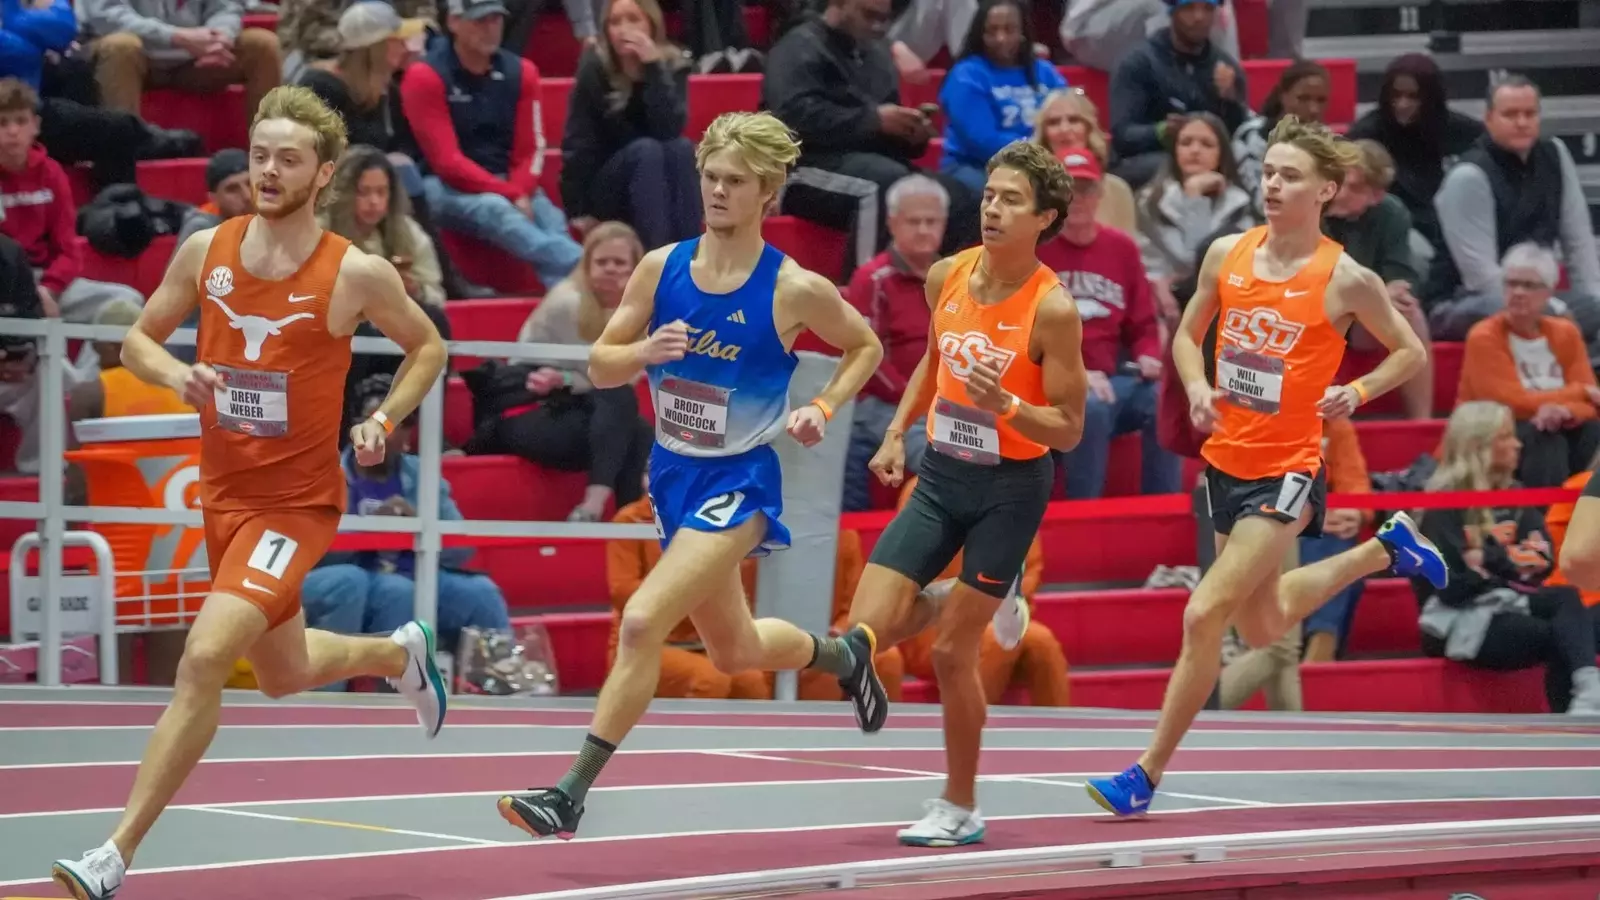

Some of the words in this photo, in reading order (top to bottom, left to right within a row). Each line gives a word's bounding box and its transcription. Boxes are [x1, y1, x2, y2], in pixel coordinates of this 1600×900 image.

[1400, 6, 1419, 31] 11
[1582, 131, 1597, 157] 9
[211, 268, 232, 288] SEC
[1221, 307, 1306, 354] OSU
[1237, 368, 1257, 383] WILL
[231, 389, 261, 405] DREW
[1228, 377, 1264, 397] CONWAY
[229, 402, 264, 419] WEBER
[673, 398, 706, 416] BRODY
[664, 407, 717, 432] WOODCOCK
[953, 420, 978, 436] JERRY
[949, 430, 984, 449] MENDEZ
[1284, 476, 1308, 512] 7
[700, 492, 736, 522] 2
[269, 537, 287, 570] 1
